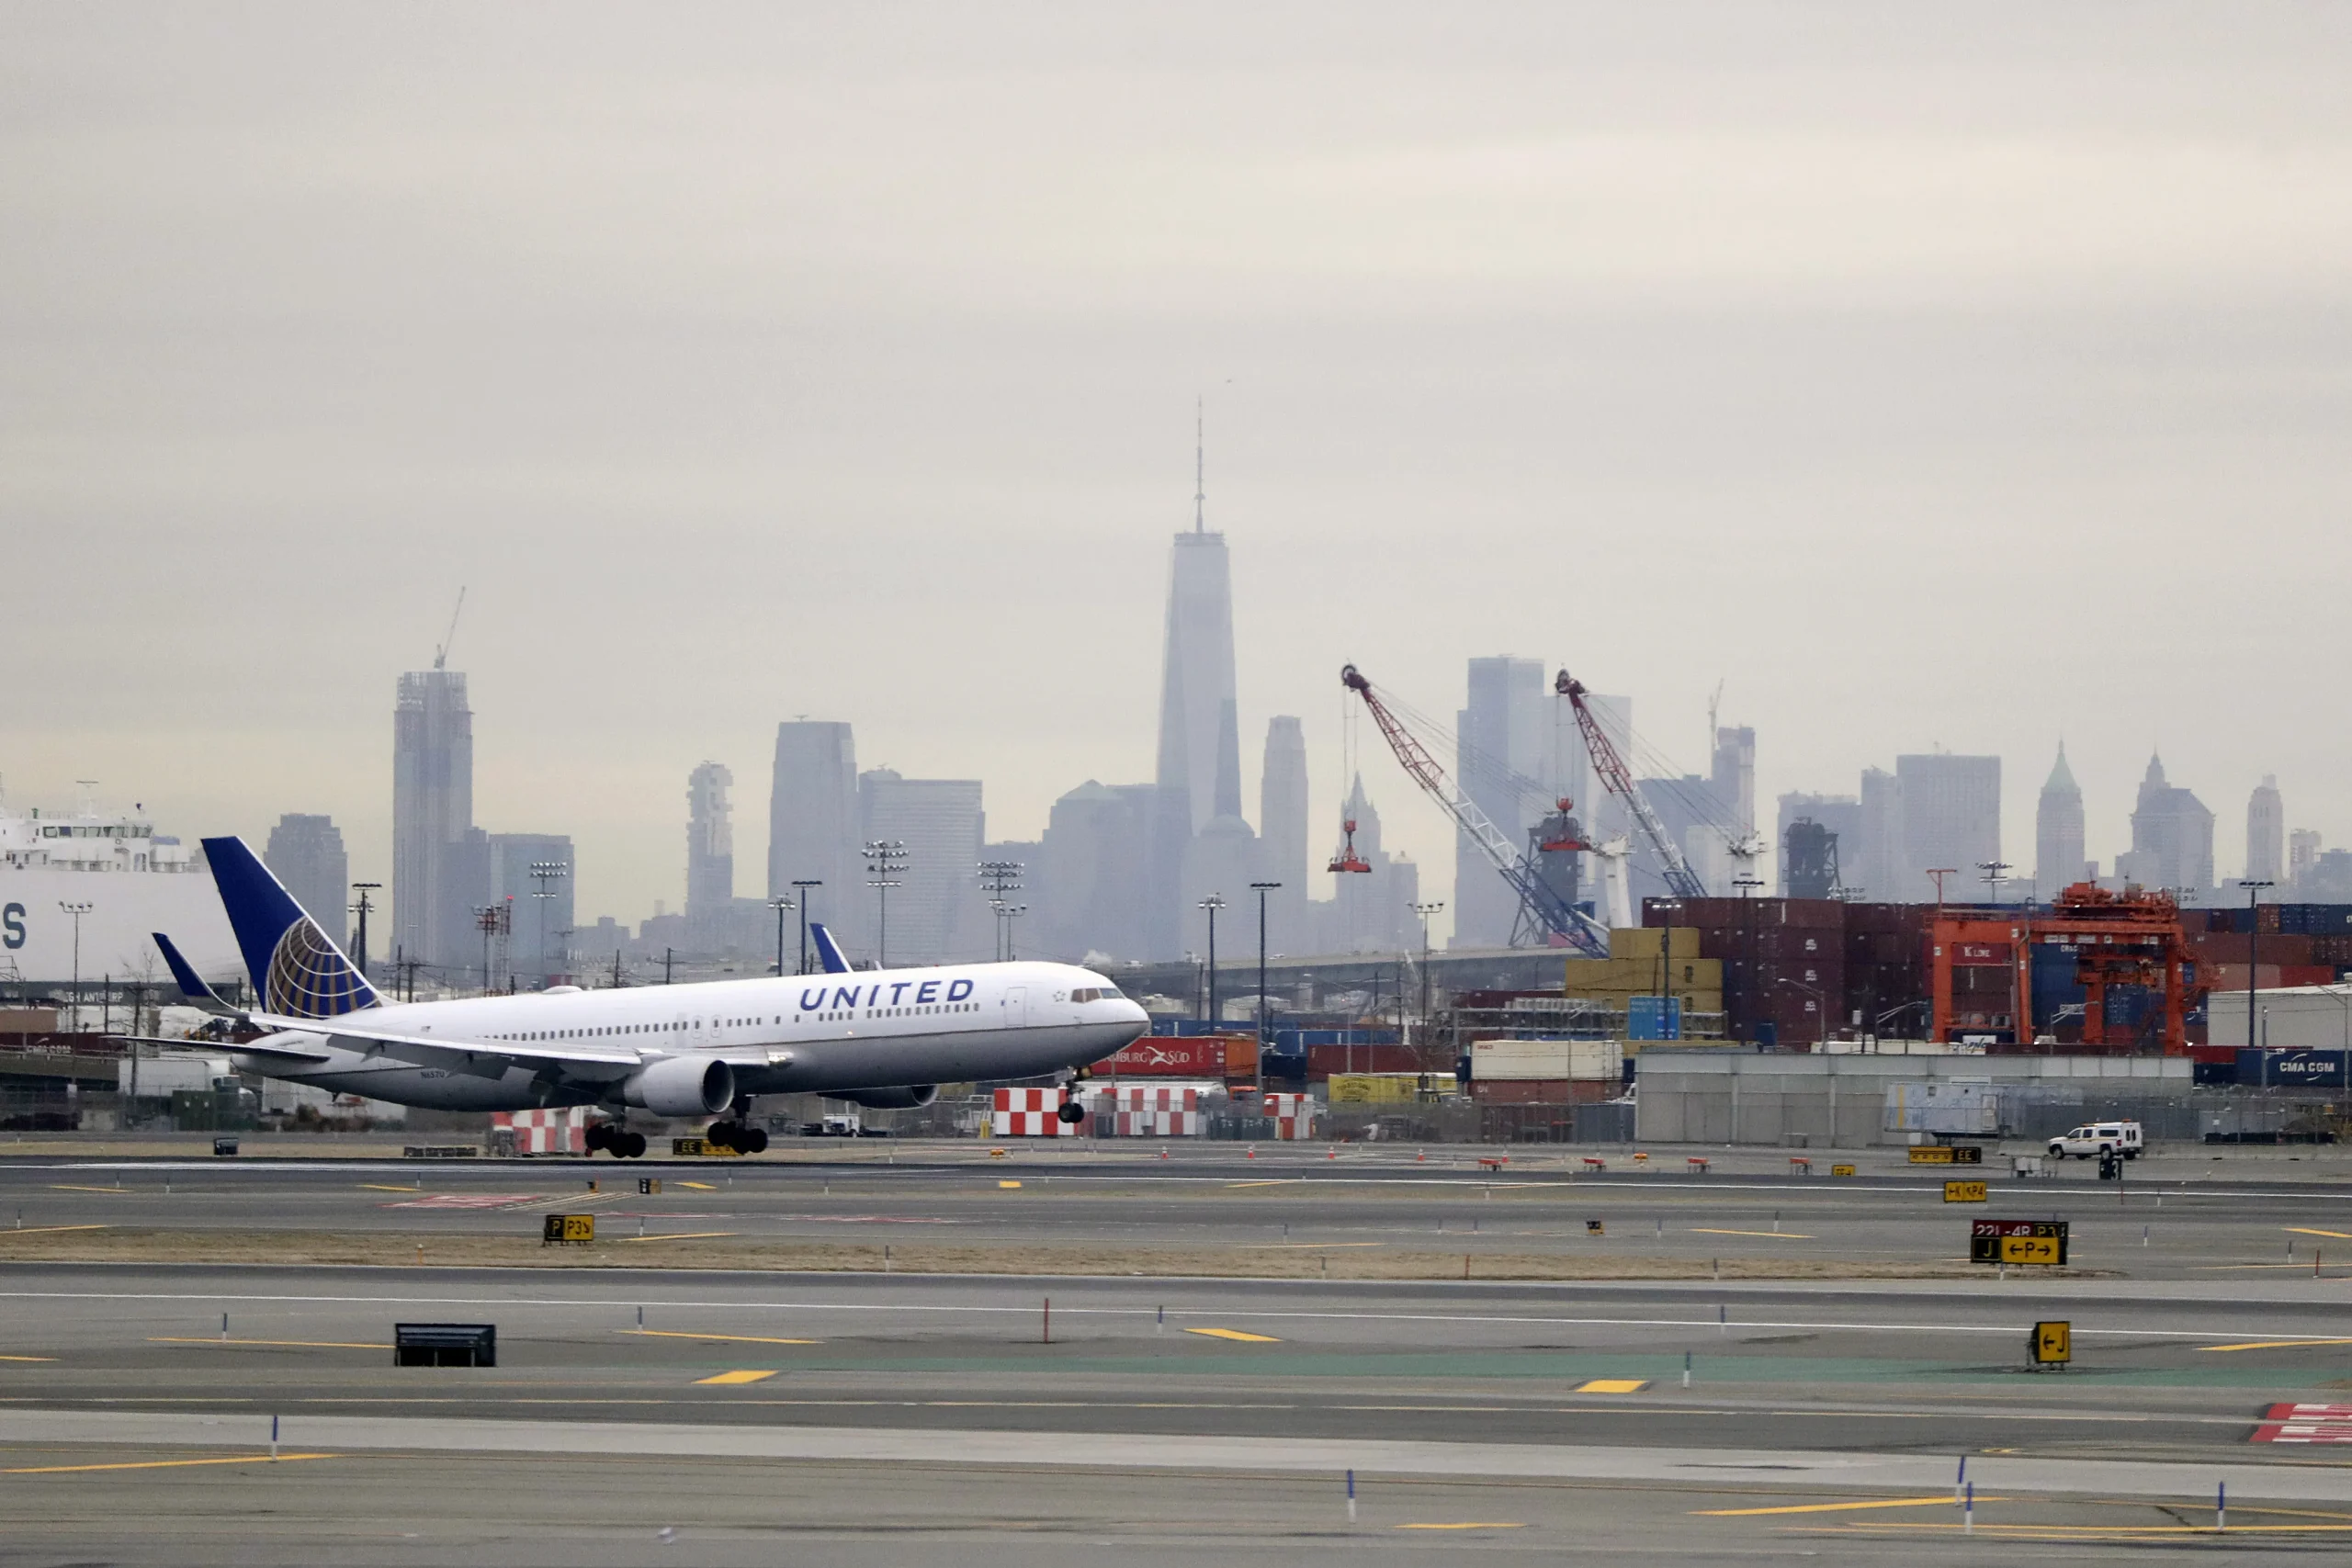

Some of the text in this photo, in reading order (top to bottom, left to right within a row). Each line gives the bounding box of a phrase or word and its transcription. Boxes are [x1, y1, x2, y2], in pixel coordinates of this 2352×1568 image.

[3, 902, 27, 949] S
[800, 979, 974, 1011] UNITED
[2279, 1062, 2335, 1073] CMA CGM
[682, 1142, 695, 1152] EE
[1958, 1150, 1972, 1160] EE
[552, 1220, 560, 1235] P
[567, 1220, 582, 1235] P3
[1983, 1240, 1993, 1258] J
[2024, 1242, 2036, 1258] P
[2057, 1330, 2065, 1353] J
